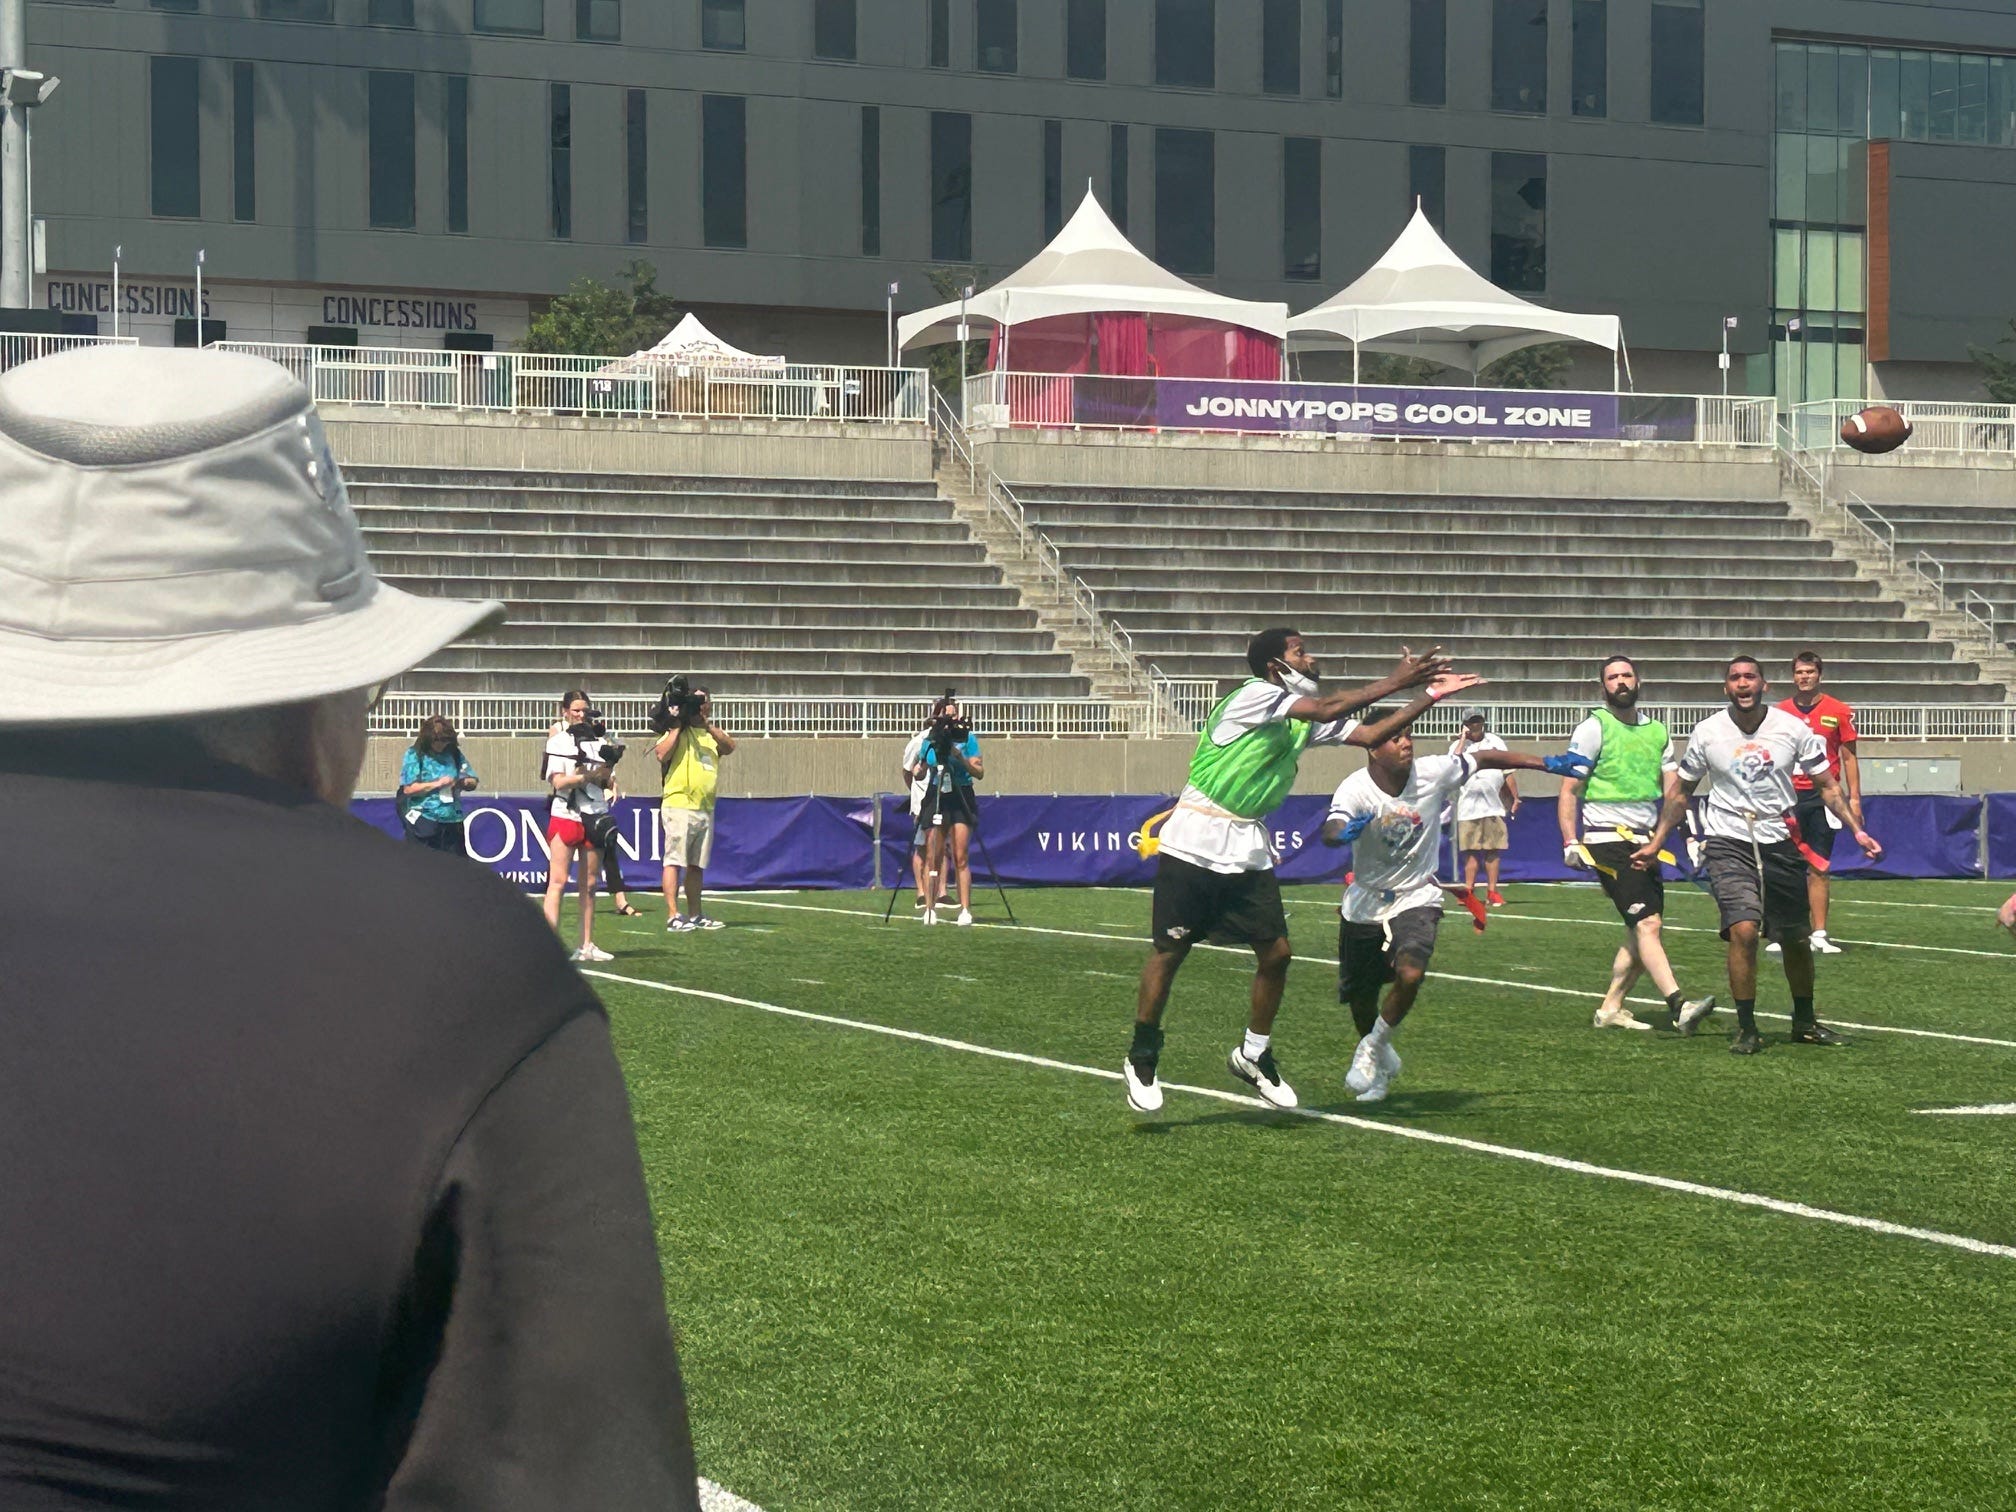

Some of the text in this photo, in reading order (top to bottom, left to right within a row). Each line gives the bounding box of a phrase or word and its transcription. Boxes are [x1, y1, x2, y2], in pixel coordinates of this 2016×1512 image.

[48, 281, 210, 318] CONCESSIONS
[323, 296, 477, 331] CONCESSIONS
[1186, 396, 1591, 428] JONNYPOPS COOL ZONE
[500, 871, 549, 884] VIKIN
